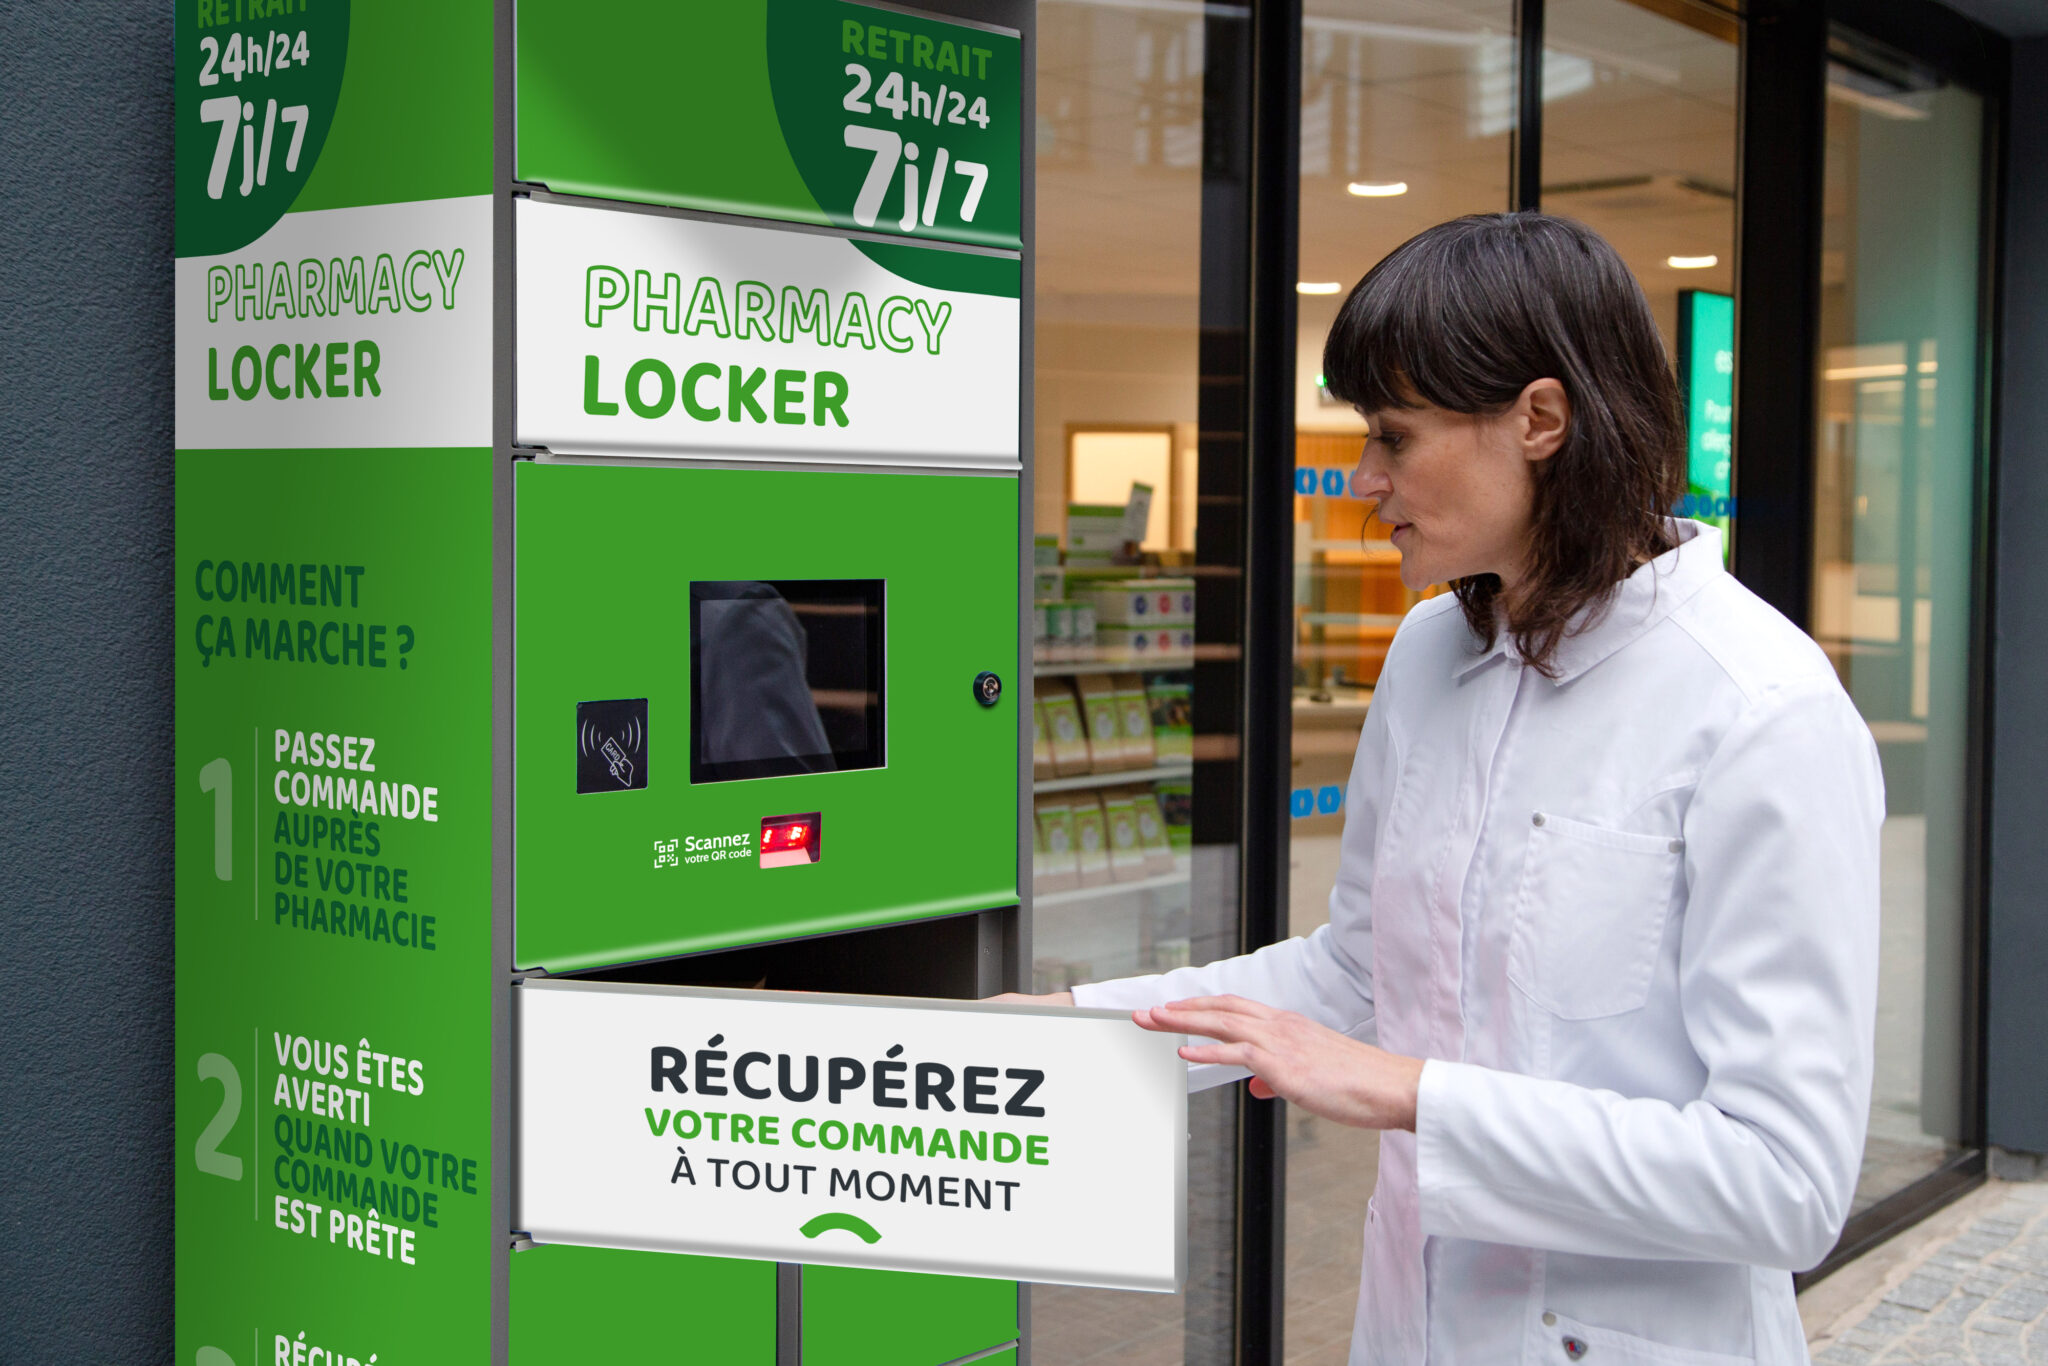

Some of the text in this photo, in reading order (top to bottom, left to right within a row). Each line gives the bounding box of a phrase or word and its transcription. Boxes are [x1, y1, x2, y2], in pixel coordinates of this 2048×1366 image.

[199, 30, 310, 86] 24h/24
[842, 19, 993, 81] RETRAIT
[842, 63, 990, 130] 24h/24
[200, 95, 309, 200] 7j/7
[843, 124, 989, 233] 7j/7
[207, 248, 465, 323] PHARMACY
[584, 265, 953, 355] PHARMACY
[208, 340, 382, 401] LOCKER
[583, 355, 850, 428] LOCKER
[195, 559, 365, 608] COMMENT
[195, 614, 415, 670] ÇA MARCHE ?
[275, 729, 376, 772] PASSEZ
[605, 742, 621, 761] CARD
[199, 757, 233, 882] 1
[274, 769, 439, 822] COMMANDE
[273, 809, 381, 857] AUPRÈS
[685, 833, 750, 852] Scannez
[685, 848, 752, 864] votre QR code
[275, 851, 408, 904] DE VOTRE
[274, 891, 437, 951] PHARMACIE
[274, 1031, 424, 1096] VOUS ÊTES
[650, 1033, 1046, 1118] RÉCUPÉREZ
[194, 1052, 244, 1182] 2
[273, 1073, 370, 1127] AVERTI
[274, 1113, 478, 1195] QUAND VOTRE
[644, 1107, 1050, 1166] VOTRE COMMANDE
[274, 1154, 439, 1229] COMMANDE
[670, 1146, 1021, 1212] À TOUT MOMENT
[275, 1194, 416, 1265] EST PRÊTE
